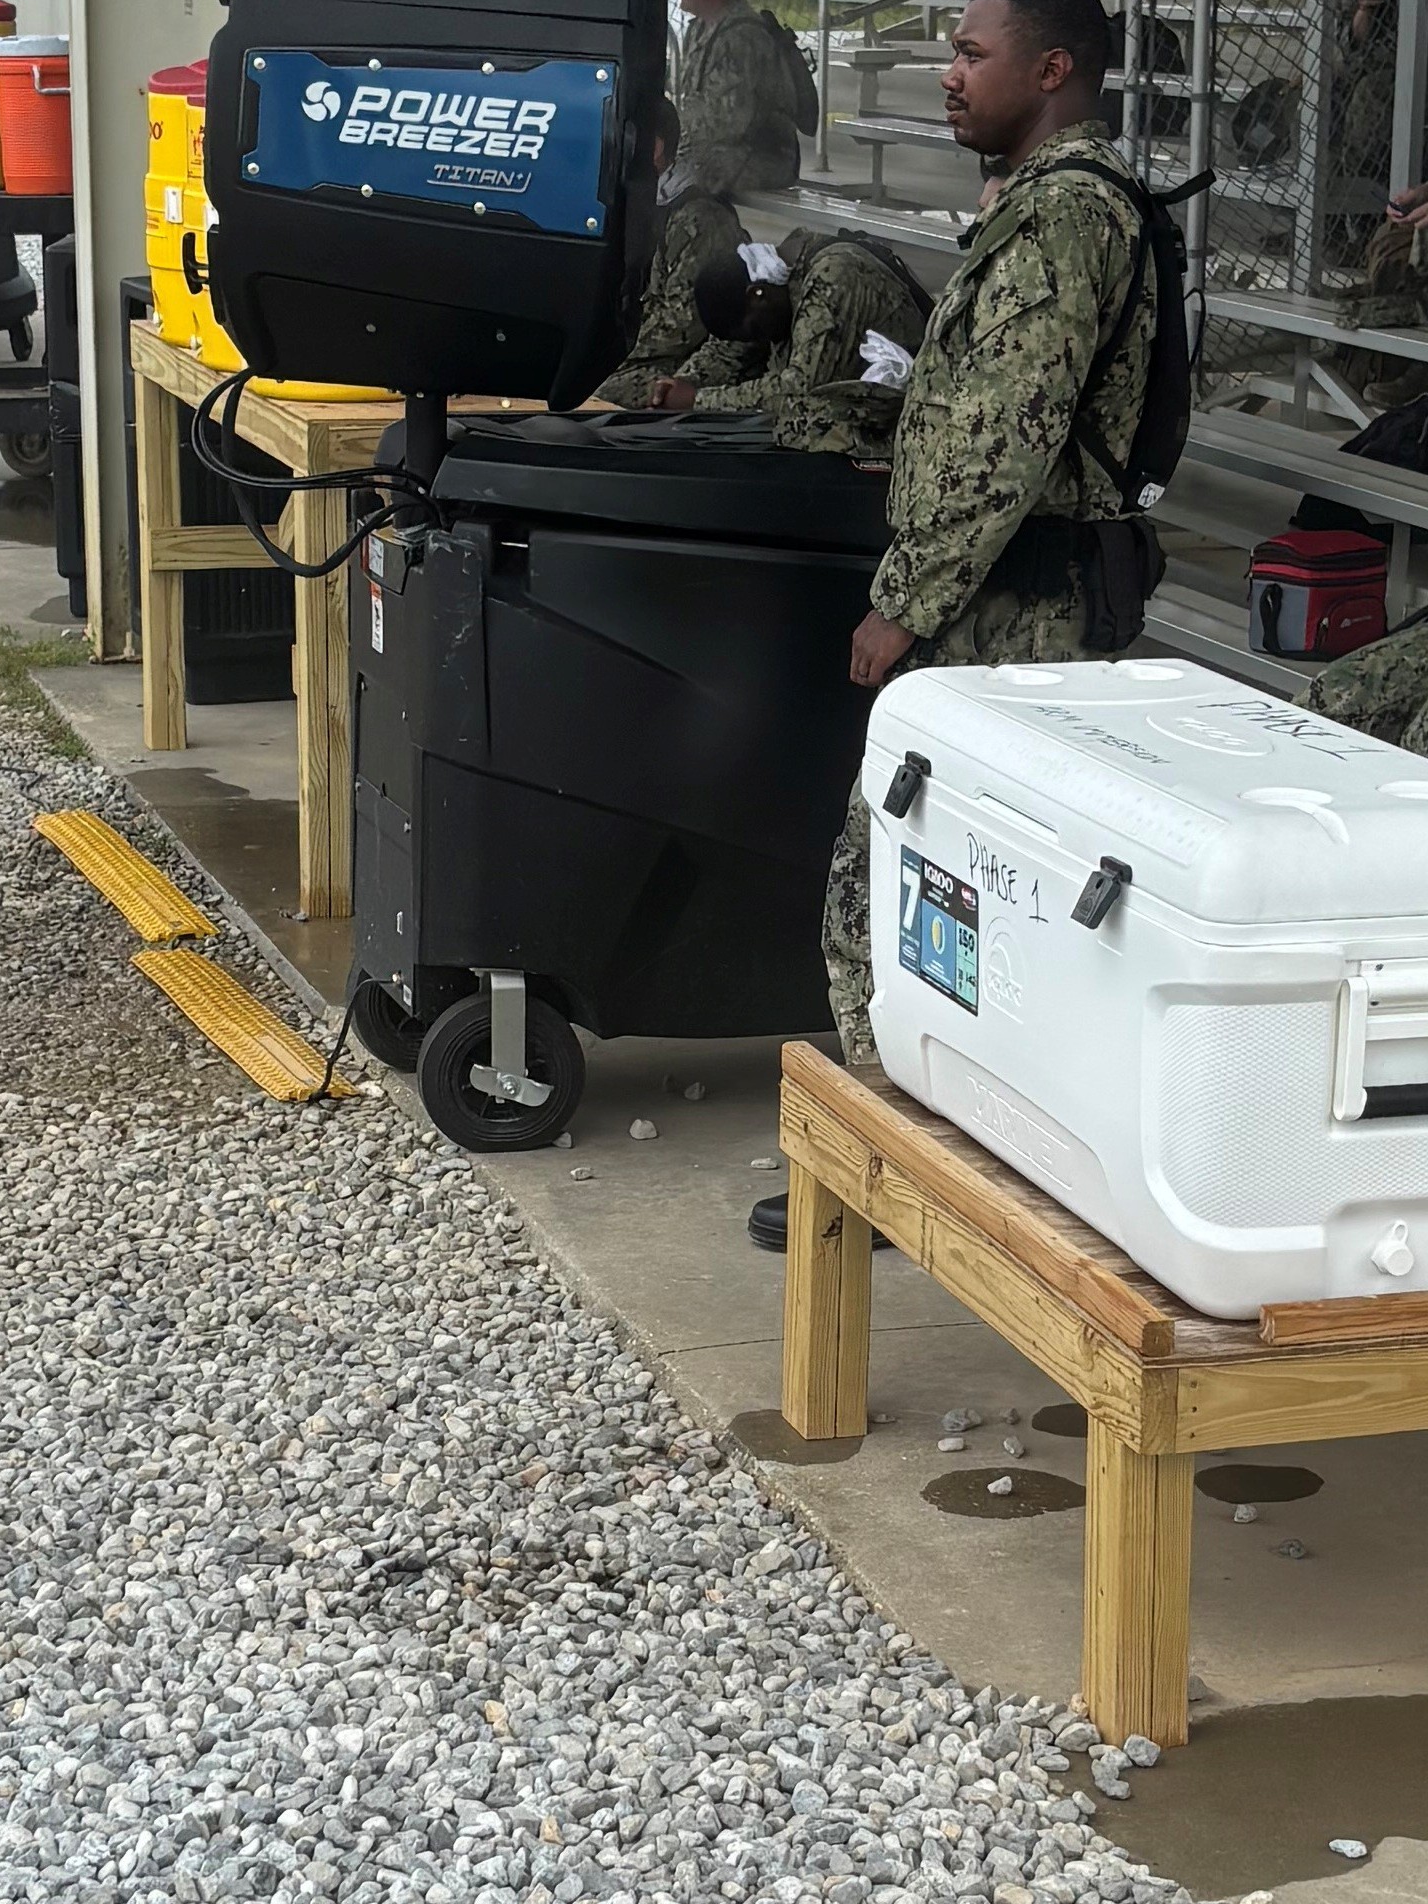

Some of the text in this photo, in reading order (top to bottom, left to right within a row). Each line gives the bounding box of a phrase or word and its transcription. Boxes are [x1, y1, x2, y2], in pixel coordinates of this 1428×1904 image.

[338, 118, 545, 160] BREEZER
[348, 86, 557, 134] POWER
[1196, 700, 1344, 740] PHASE
[1301, 744, 1388, 762] 1
[902, 864, 921, 932] 7
[966, 832, 1018, 905] PHASE
[1028, 878, 1050, 924] 1
